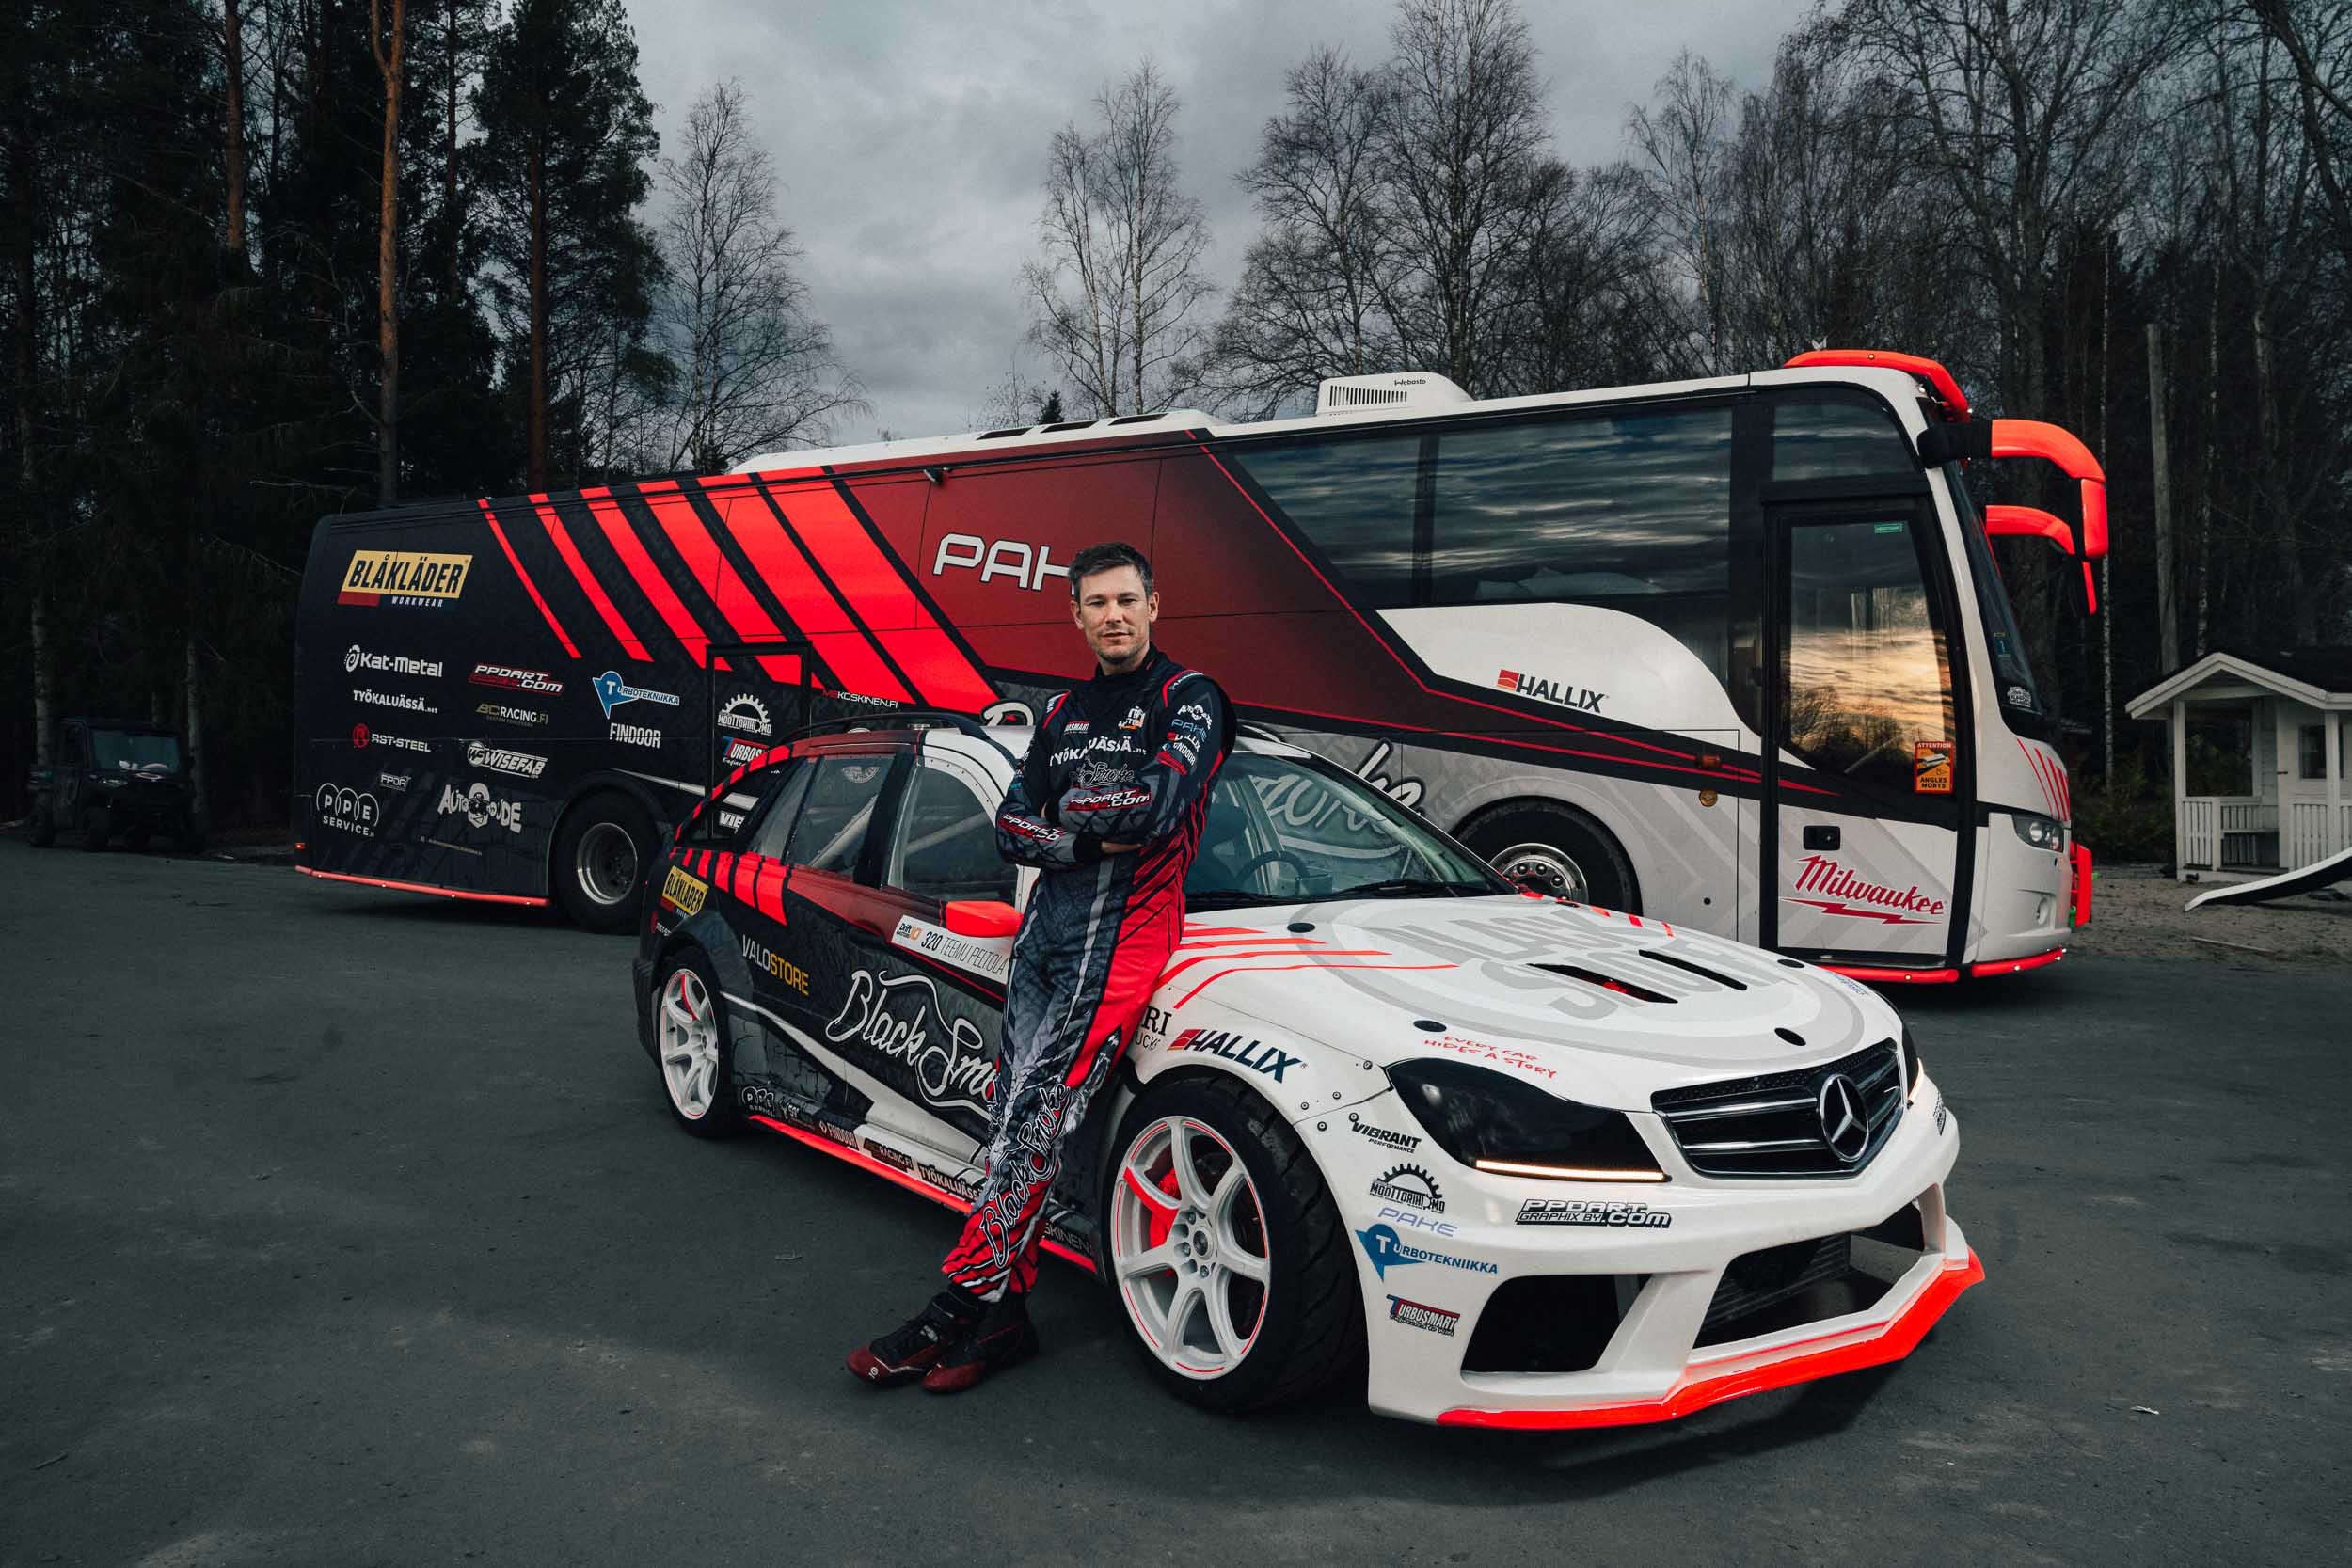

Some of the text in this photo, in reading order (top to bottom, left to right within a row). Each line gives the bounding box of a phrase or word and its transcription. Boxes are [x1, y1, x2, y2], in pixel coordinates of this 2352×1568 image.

[348, 553, 464, 593] BLÅKLÄDER
[391, 595, 444, 608] WORKWEAR
[1516, 673, 1605, 713] HALLIX
[609, 722, 662, 749] FINDOOR
[484, 750, 546, 775] WISEFAB
[1795, 855, 1945, 915] Milwaukee
[742, 934, 809, 996] VALOSTORE
[921, 931, 1009, 975] 320 TEEMU PELTOLA
[825, 970, 928, 1068] Black
[1184, 1029, 1302, 1084] HALLIX
[1423, 1039, 1557, 1079] HIDES A STORY
[1352, 1122, 1422, 1148] VIBRANT
[1368, 1138, 1415, 1154] PERFORMANCE
[919, 1164, 979, 1202] TYÖKALUÄSS
[1378, 1207, 1458, 1238] PAKE
[1518, 1212, 1581, 1222] GRAPHIX
[1583, 1212, 1602, 1222] BY
[1375, 1234, 1498, 1274] TURBOTEKNIIKKA
[1386, 1294, 1460, 1330] TURBOSMART
